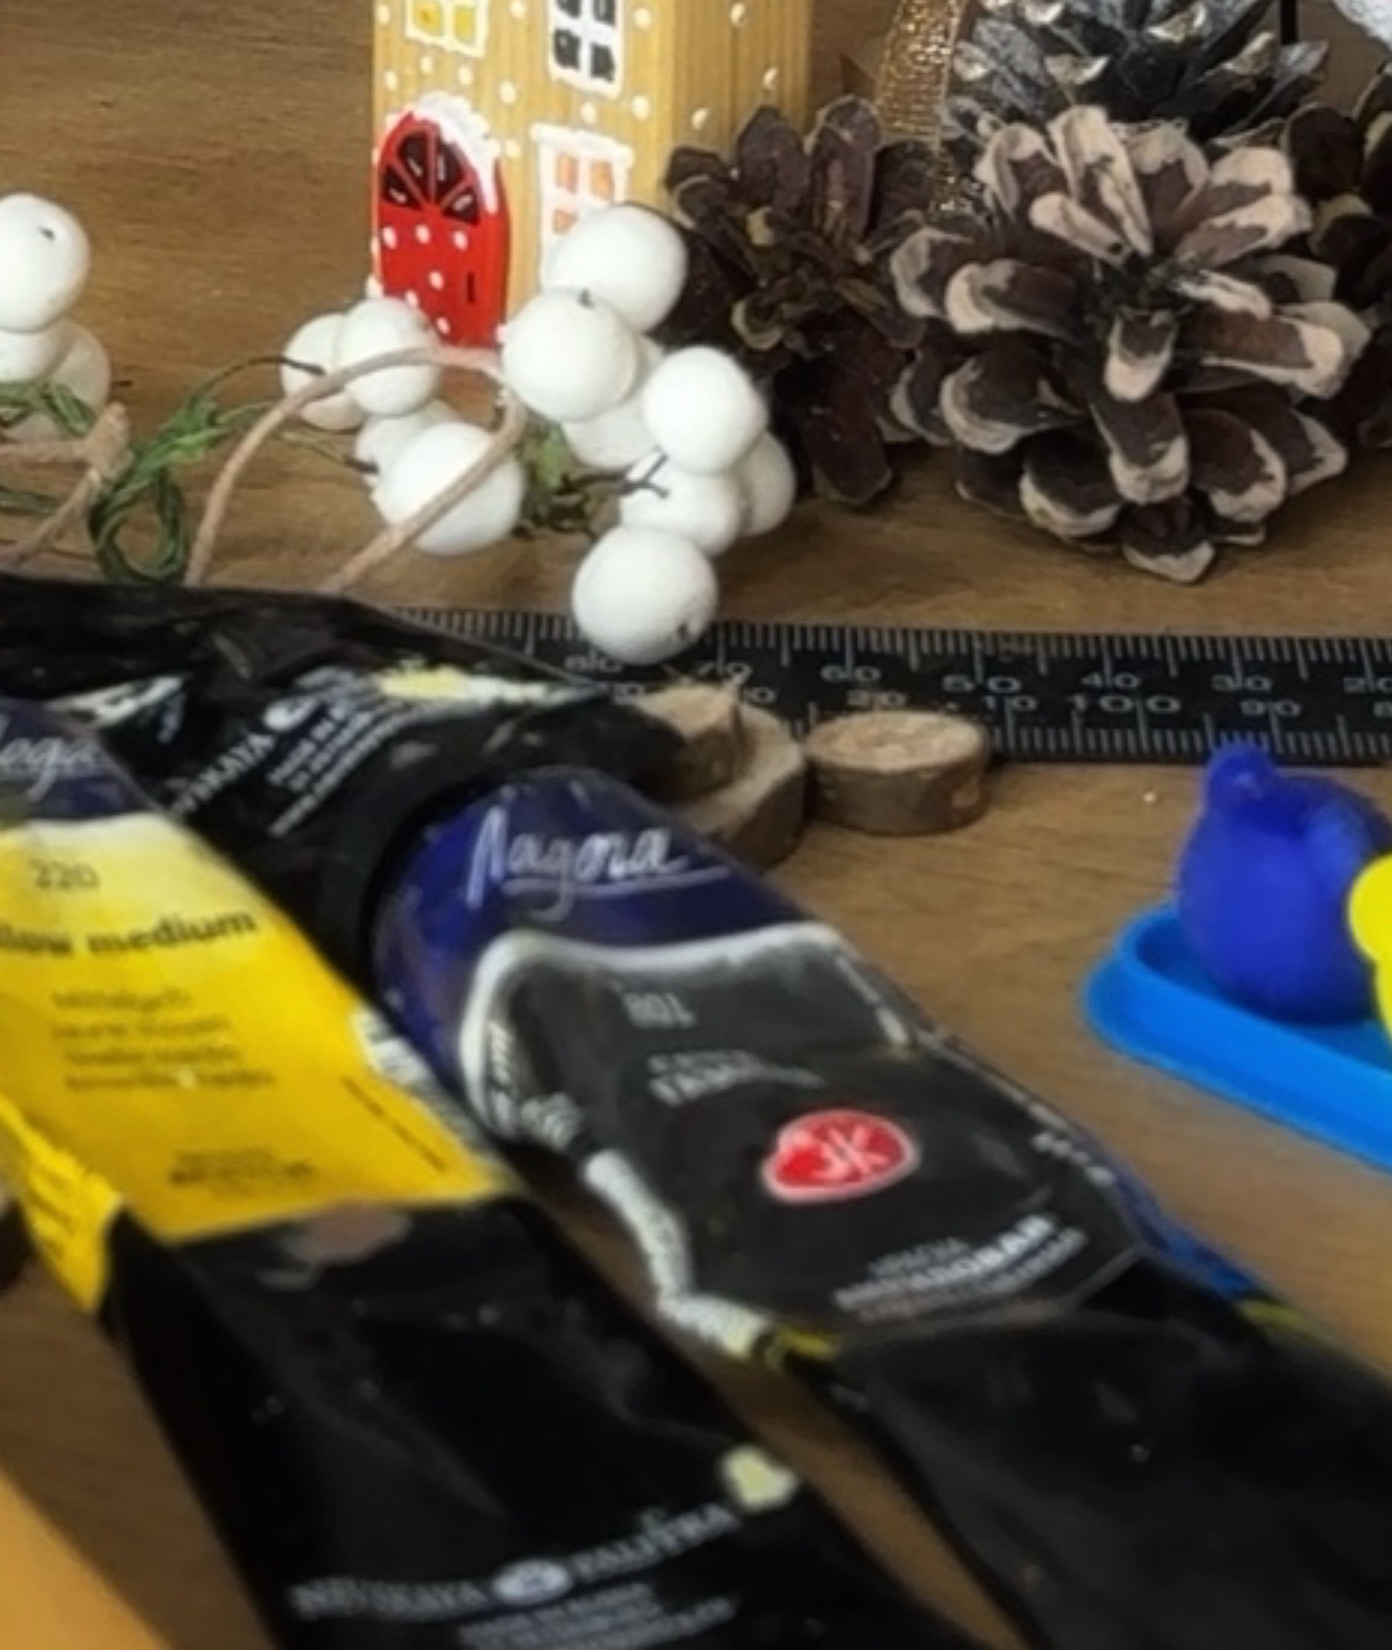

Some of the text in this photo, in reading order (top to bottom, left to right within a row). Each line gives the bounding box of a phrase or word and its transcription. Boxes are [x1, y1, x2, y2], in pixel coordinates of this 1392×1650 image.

[1081, 671, 1140, 689] 40
[1210, 673, 1272, 692] 30
[29, 860, 99, 890] 220
[87, 911, 257, 955] medium
